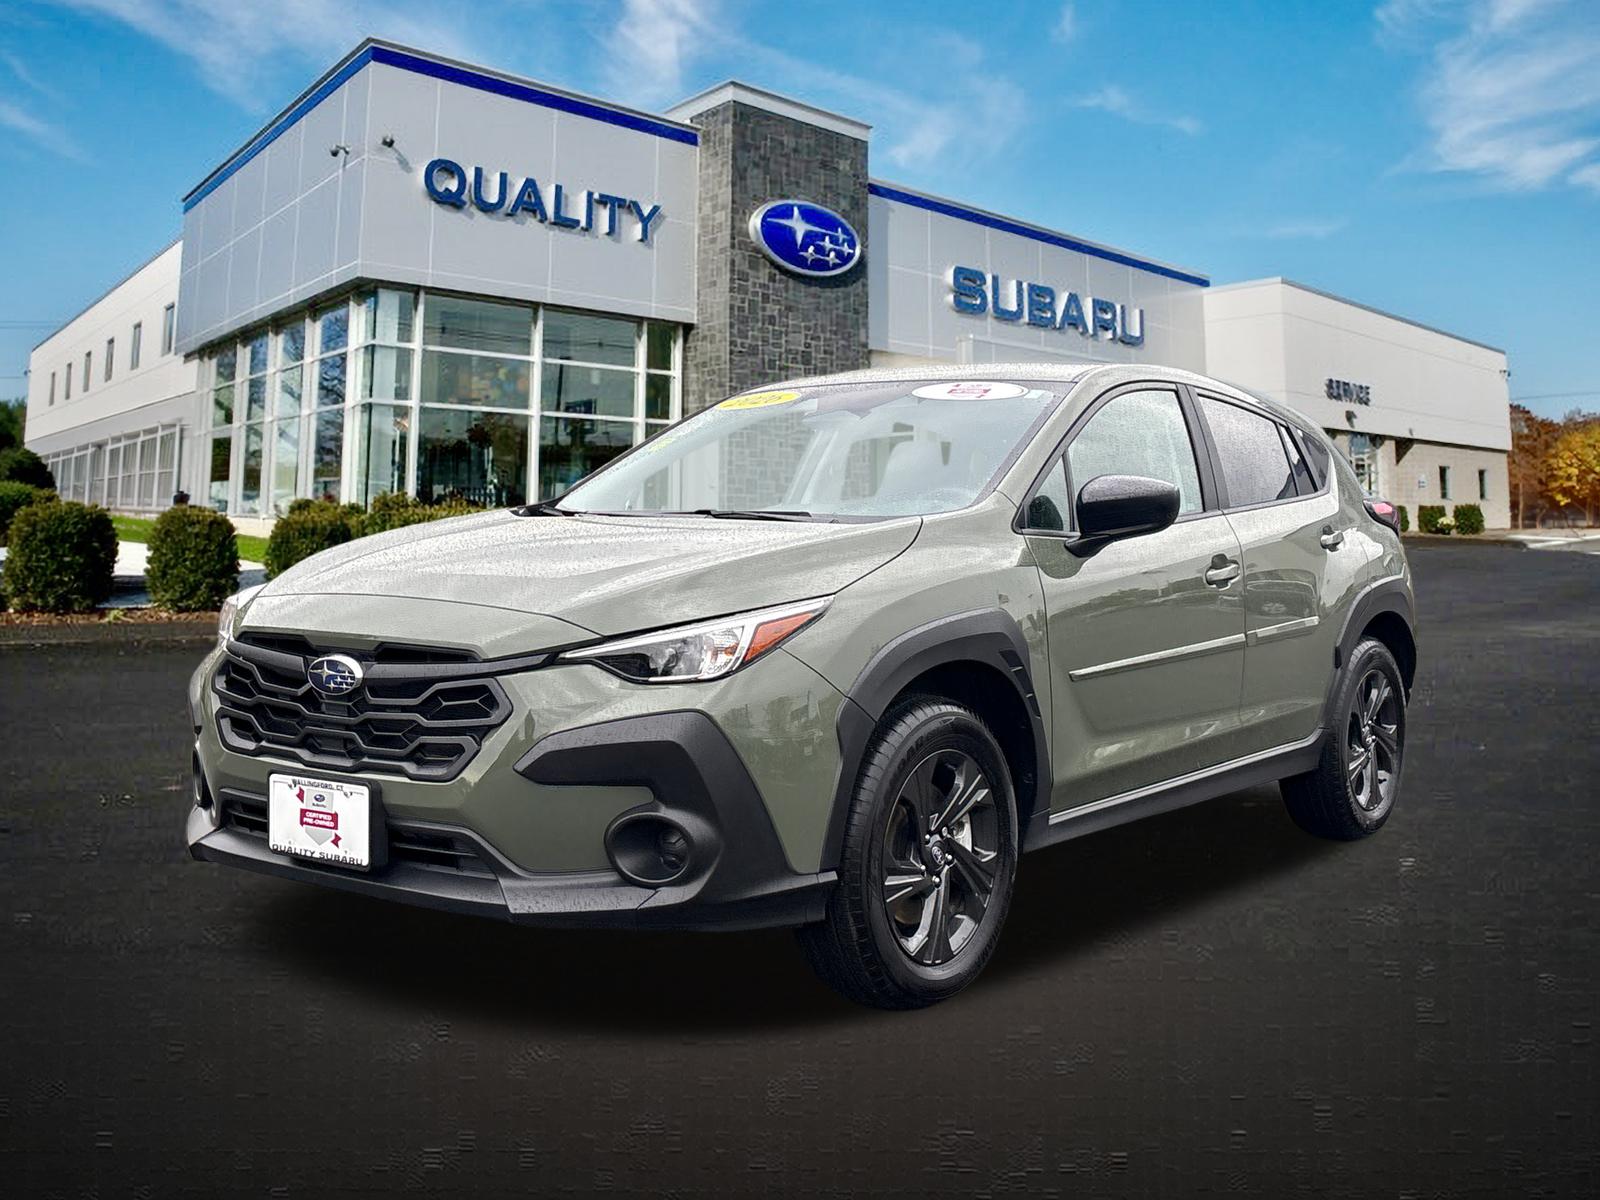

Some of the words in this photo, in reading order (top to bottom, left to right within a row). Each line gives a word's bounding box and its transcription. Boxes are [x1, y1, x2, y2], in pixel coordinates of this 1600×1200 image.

[423, 158, 662, 243] QUALITY
[948, 265, 1145, 347] SUBARU
[1325, 378, 1371, 406] SERVICE
[303, 817, 334, 827] PRE-OWNED
[305, 811, 332, 821] CERTIFIED
[272, 843, 315, 857] QUALITY
[319, 851, 363, 865] SUBARU
